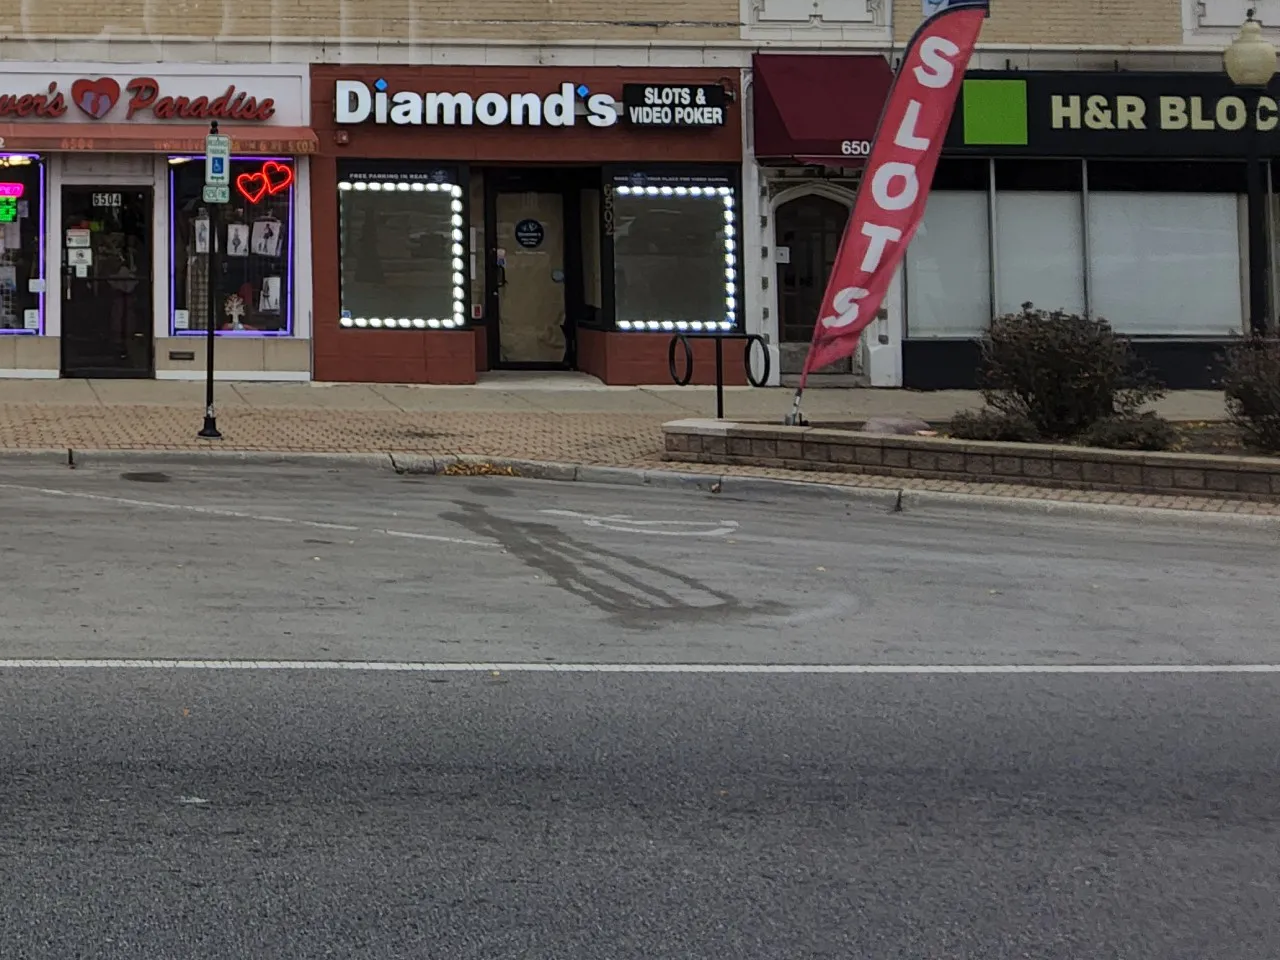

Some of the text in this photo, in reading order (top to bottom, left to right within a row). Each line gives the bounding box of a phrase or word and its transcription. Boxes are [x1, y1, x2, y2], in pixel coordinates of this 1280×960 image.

[126, 76, 276, 121] Paradise
[335, 79, 618, 128] Diamond's
[644, 87, 707, 105] SLOTS &
[629, 106, 723, 125] VIDEO POKER
[1051, 95, 1147, 130] H&R
[841, 140, 873, 155] 650
[822, 36, 960, 329] SLOTS
[93, 192, 121, 206] 6504
